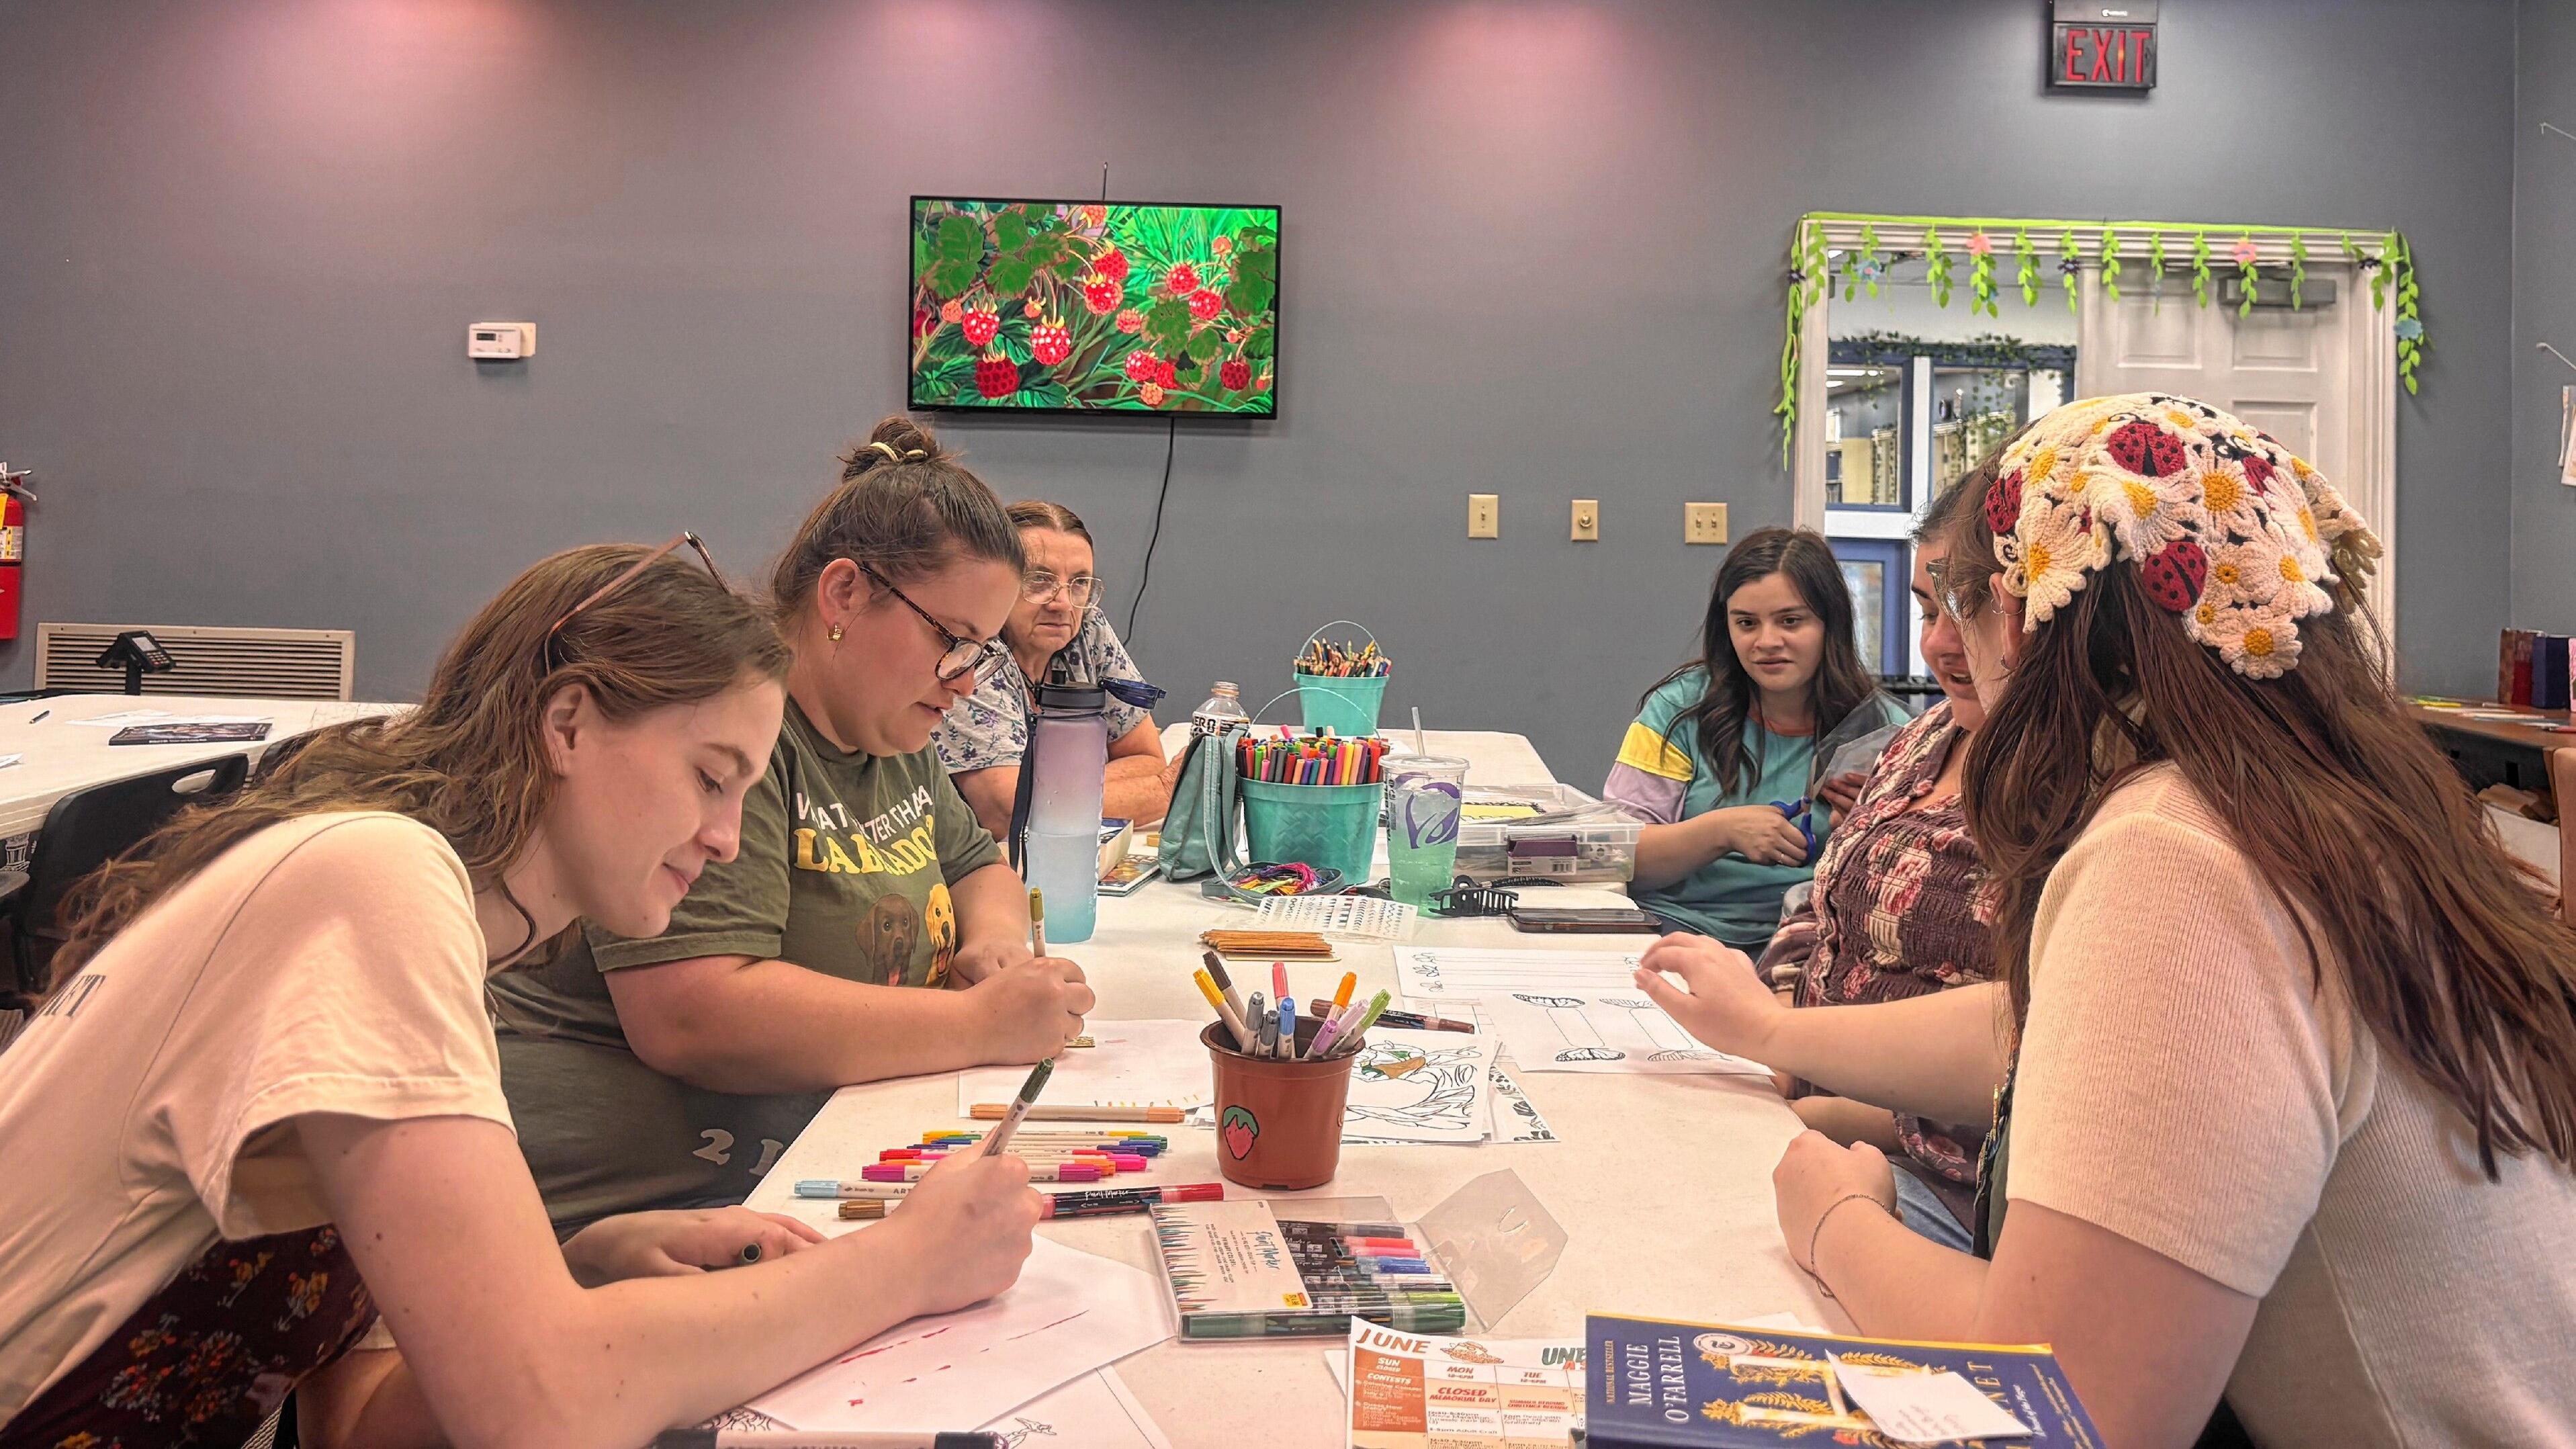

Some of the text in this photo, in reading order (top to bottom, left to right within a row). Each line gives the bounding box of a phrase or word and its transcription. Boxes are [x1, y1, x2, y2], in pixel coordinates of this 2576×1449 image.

[2066, 29, 2151, 83] EXIT
[1356, 1328, 1431, 1354] JUNE
[1378, 1357, 1401, 1366] SUN
[1447, 1366, 1474, 1374] MON
[1626, 1344, 1652, 1406] MAGGIE
[1367, 1372, 1412, 1385] CONTESTS
[1658, 1335, 1689, 1423] O'FARRELL
[1429, 1394, 1476, 1403] MEMORIAL
[1438, 1387, 1487, 1397] CLOSED
